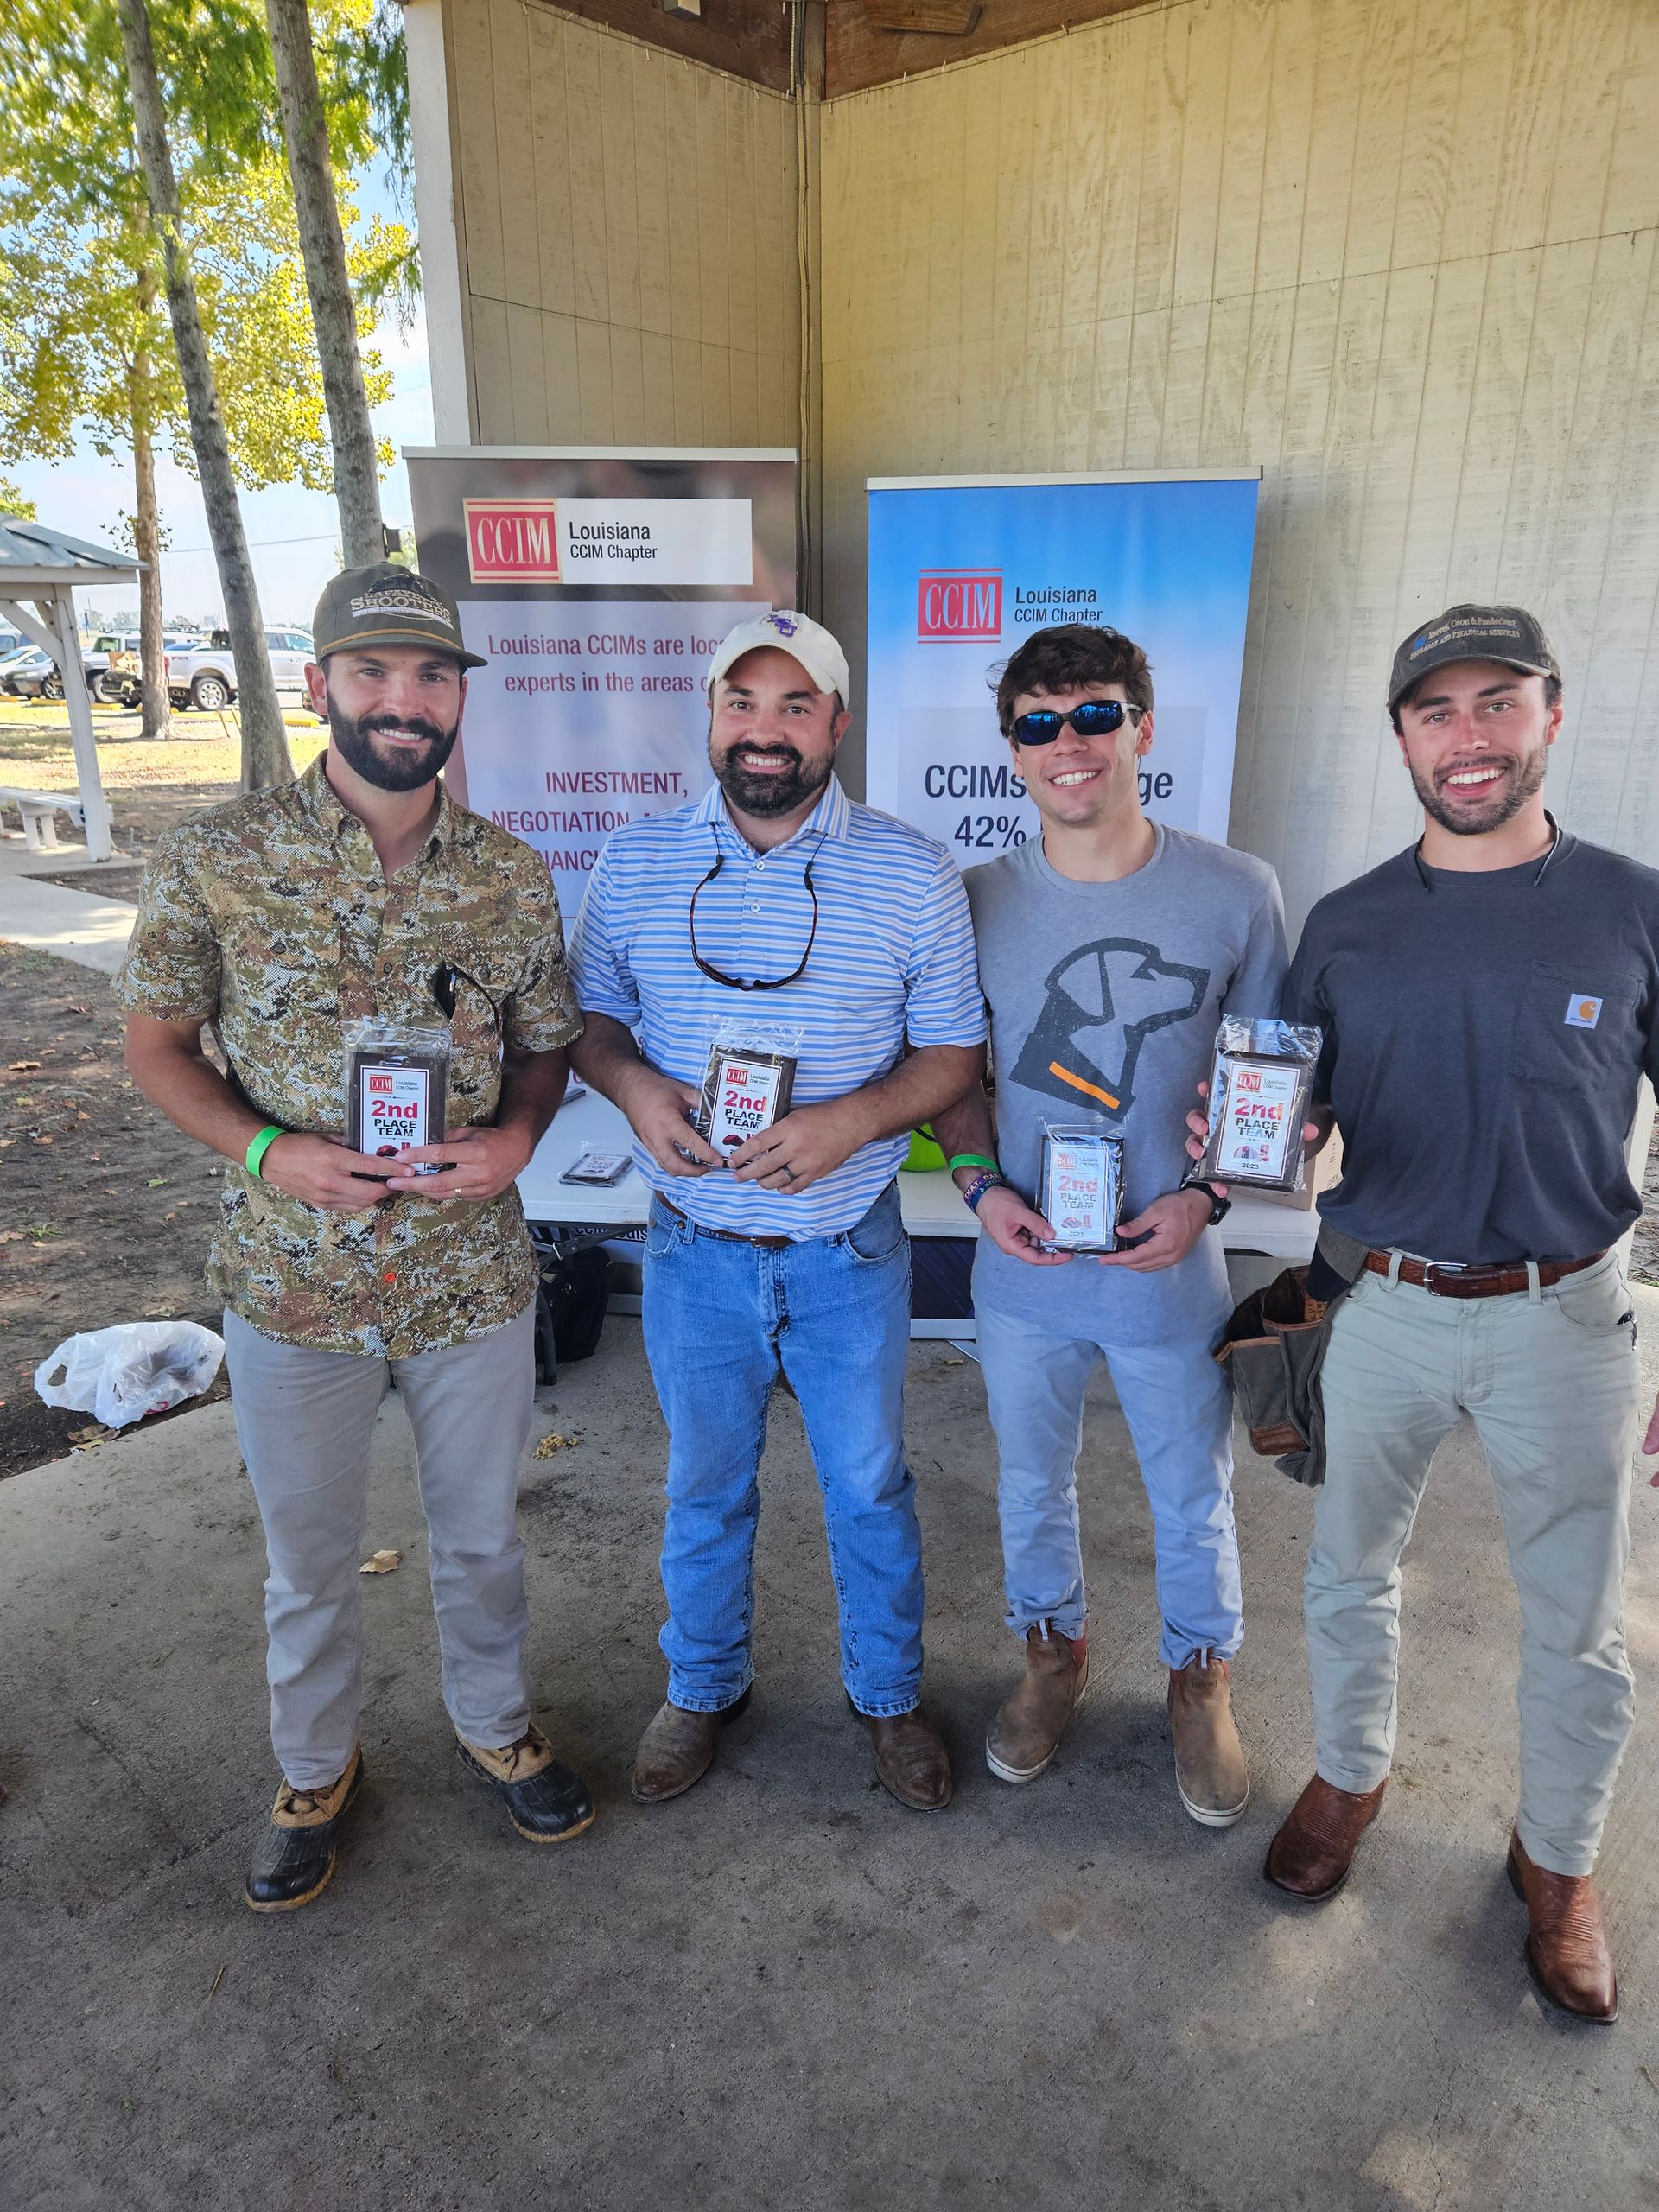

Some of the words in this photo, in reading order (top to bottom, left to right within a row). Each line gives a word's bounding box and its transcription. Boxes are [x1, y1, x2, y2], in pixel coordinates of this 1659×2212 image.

[569, 522, 651, 540] Louisiana
[477, 518, 551, 564] CCIM
[570, 544, 603, 558] CCIM
[607, 544, 658, 562] Chapter
[1016, 586, 1096, 604] Louisiana
[350, 597, 451, 622] SHOOTERS
[925, 582, 996, 629] CCIM
[1014, 608, 1047, 622] CCIM
[1052, 608, 1103, 623] Chapter
[489, 634, 581, 655] Louisiana
[588, 634, 646, 655] CCIMs
[653, 639, 683, 655] are
[690, 634, 724, 655] loc
[505, 673, 575, 695] experts
[582, 672, 599, 691] in
[605, 672, 634, 691] the
[641, 676, 693, 692] areas
[545, 772, 688, 797] INVESTMENT,
[925, 765, 1027, 798] CCIMs
[954, 815, 1027, 848] 42%
[371, 1099, 418, 1119] 2nd
[724, 1090, 767, 1112] 2nd
[1234, 1097, 1284, 1121] 2nd
[374, 1118, 416, 1128] PLACE
[725, 1109, 764, 1122] PLACE
[727, 1116, 760, 1129] TEAM
[1236, 1118, 1281, 1131] PLACE
[377, 1127, 413, 1137] TEAM
[1237, 1127, 1275, 1140] TEAM
[1058, 1175, 1098, 1192] 2nd
[1060, 1193, 1096, 1202] PLACE
[1062, 1200, 1094, 1209] TEAM
